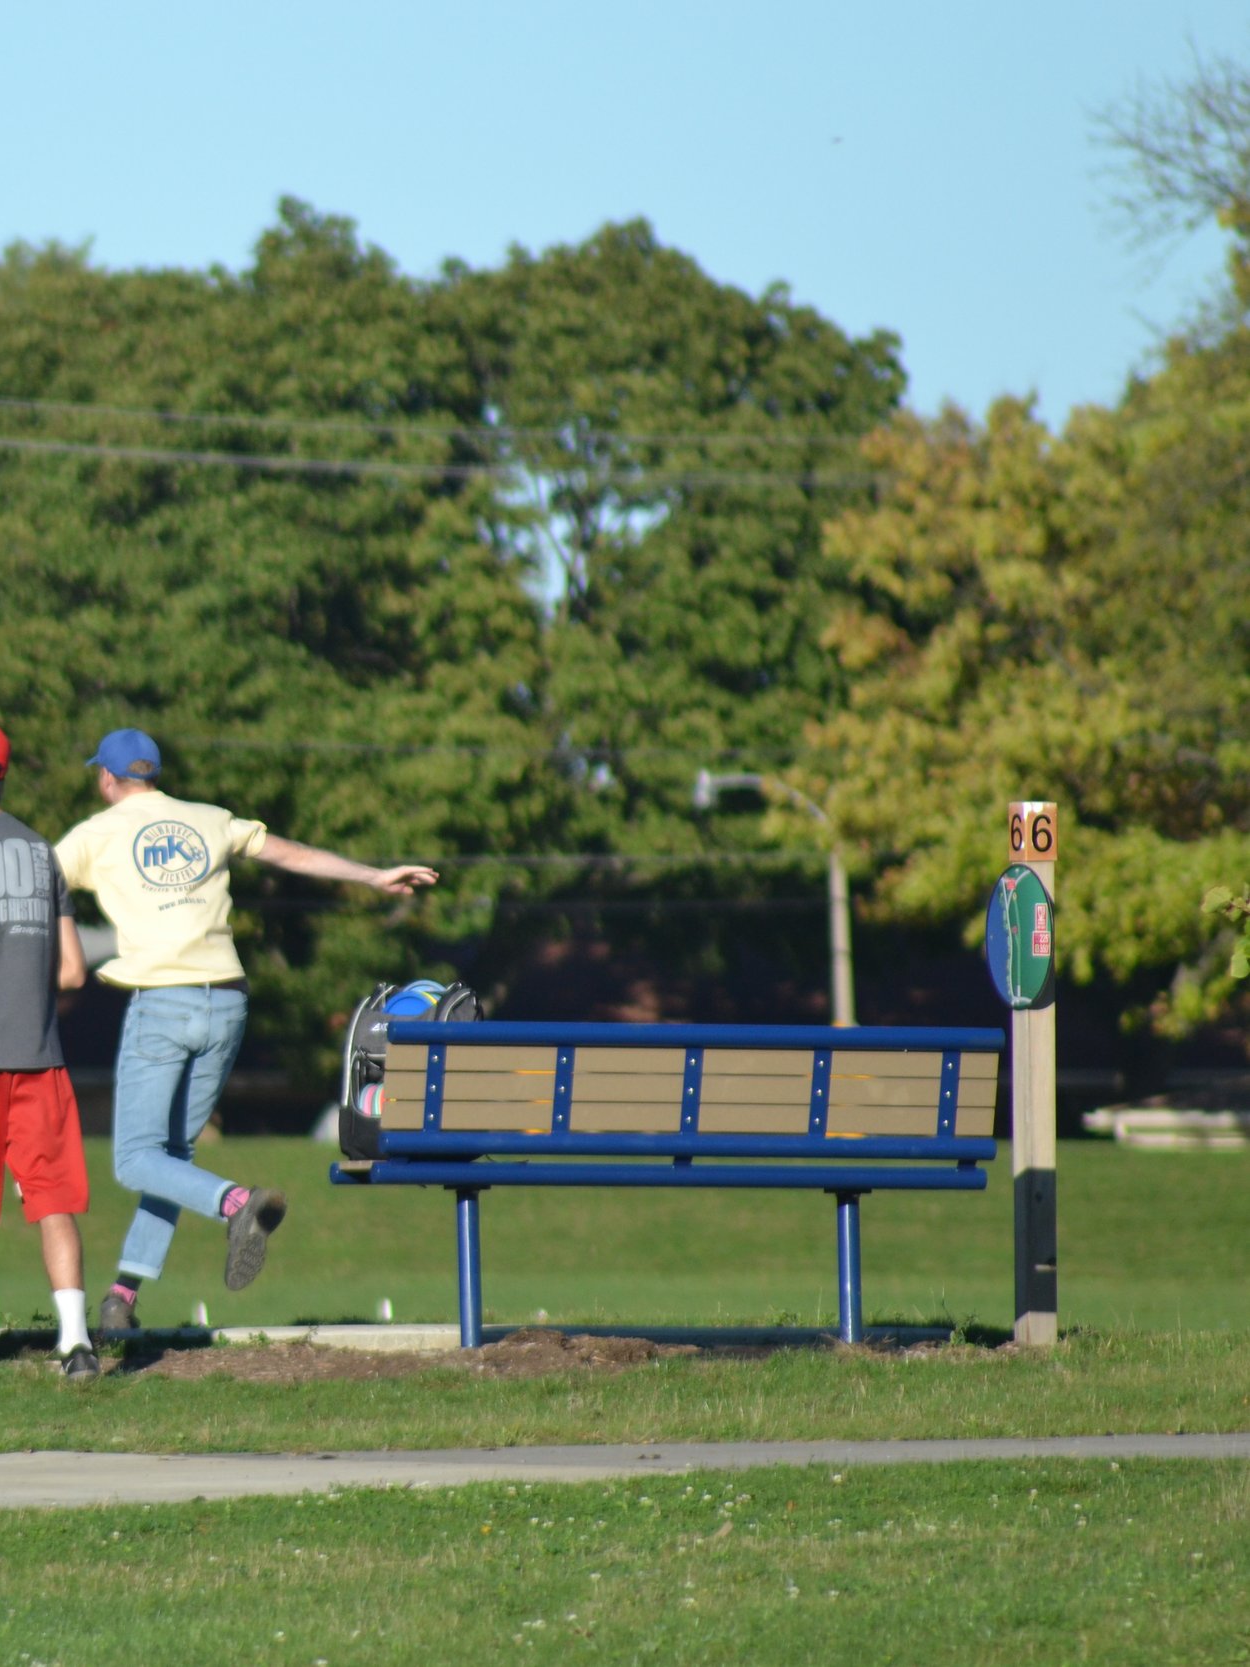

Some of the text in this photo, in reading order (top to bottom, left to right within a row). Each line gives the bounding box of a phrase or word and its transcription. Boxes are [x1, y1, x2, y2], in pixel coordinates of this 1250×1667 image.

[143, 824, 193, 842] MILWAUKEE
[1011, 813, 1022, 851] 6
[1032, 814, 1053, 852] 6
